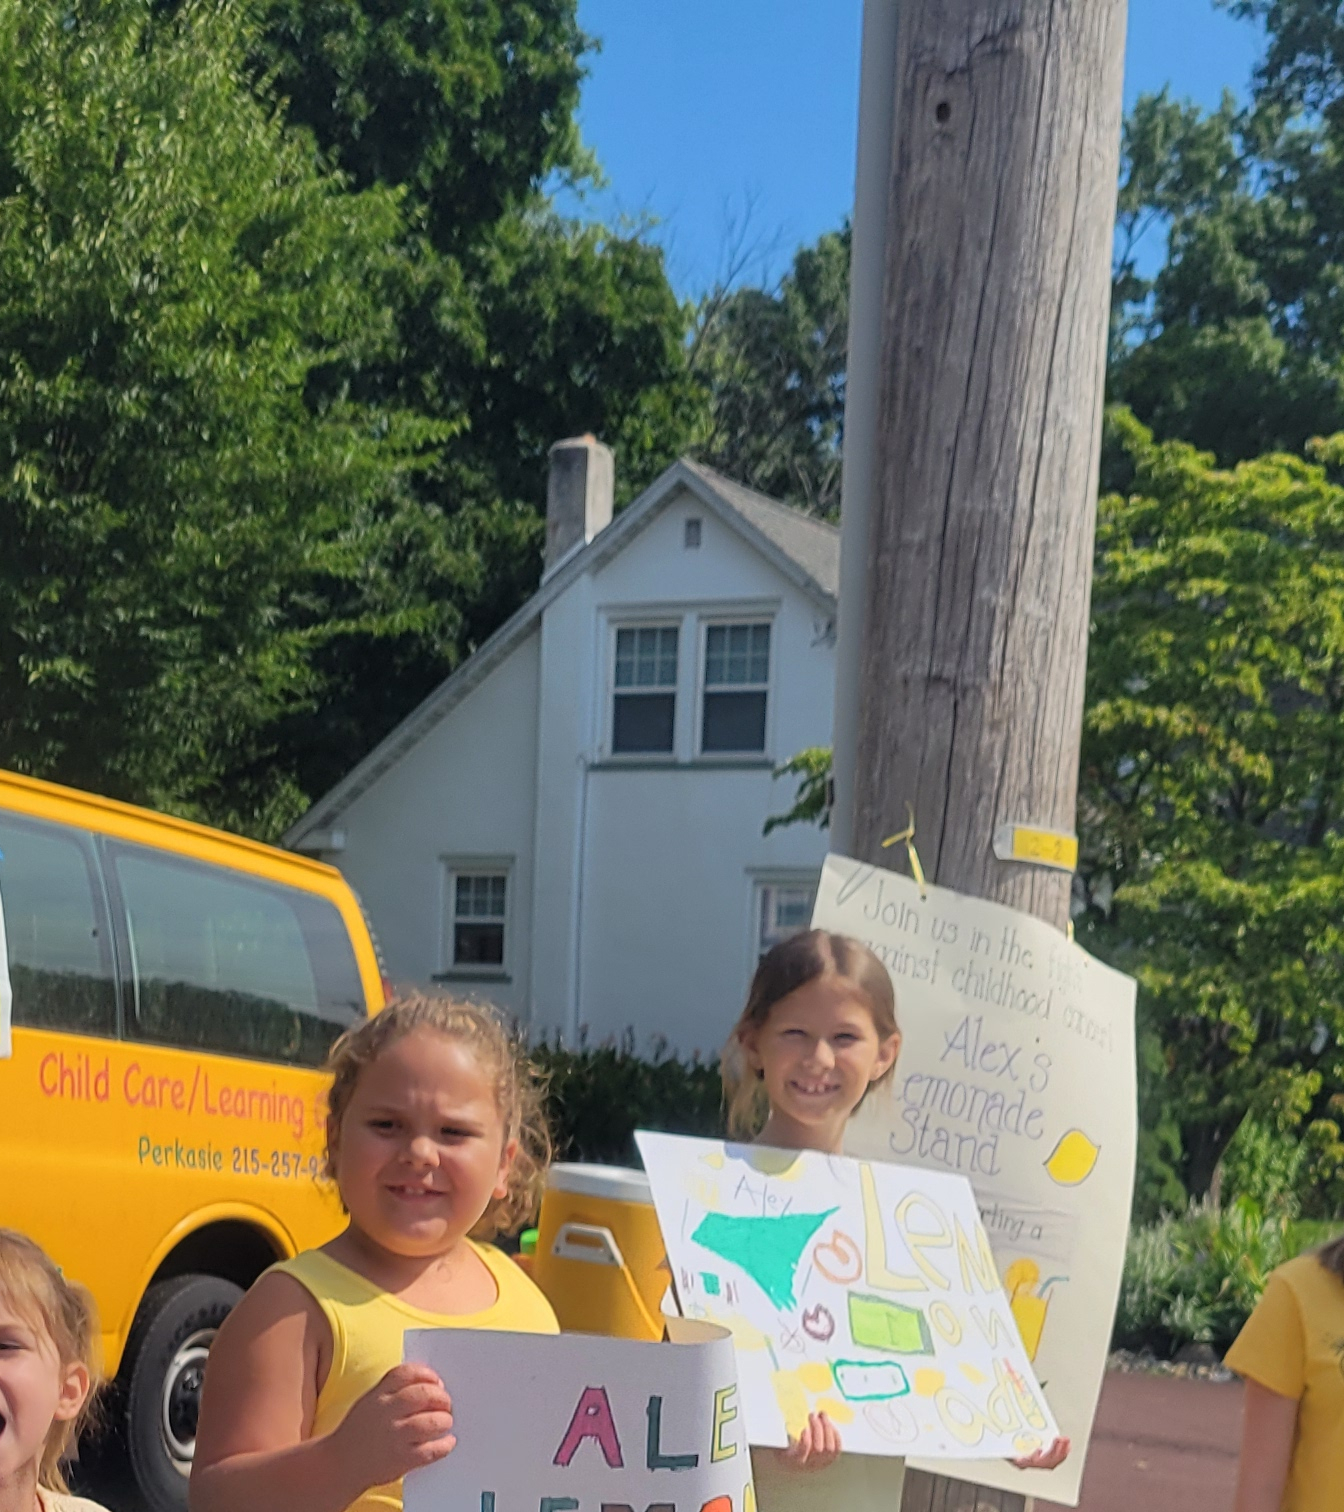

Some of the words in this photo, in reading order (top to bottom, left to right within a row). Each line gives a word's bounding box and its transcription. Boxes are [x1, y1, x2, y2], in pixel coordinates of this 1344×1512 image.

[863, 879, 920, 934] Join
[931, 917, 960, 944] us
[969, 927, 991, 956] in
[1000, 925, 1033, 969] the
[867, 941, 940, 986] ainst
[952, 959, 1054, 1020] childhood
[39, 1052, 110, 1103] Child
[123, 1062, 305, 1139] Care/Learning
[899, 1072, 1045, 1141] emonade
[138, 1135, 223, 1172] Perkasie
[888, 1103, 1001, 1176] Stand
[978, 1202, 1024, 1241] rting
[1030, 1224, 1043, 1241] a
